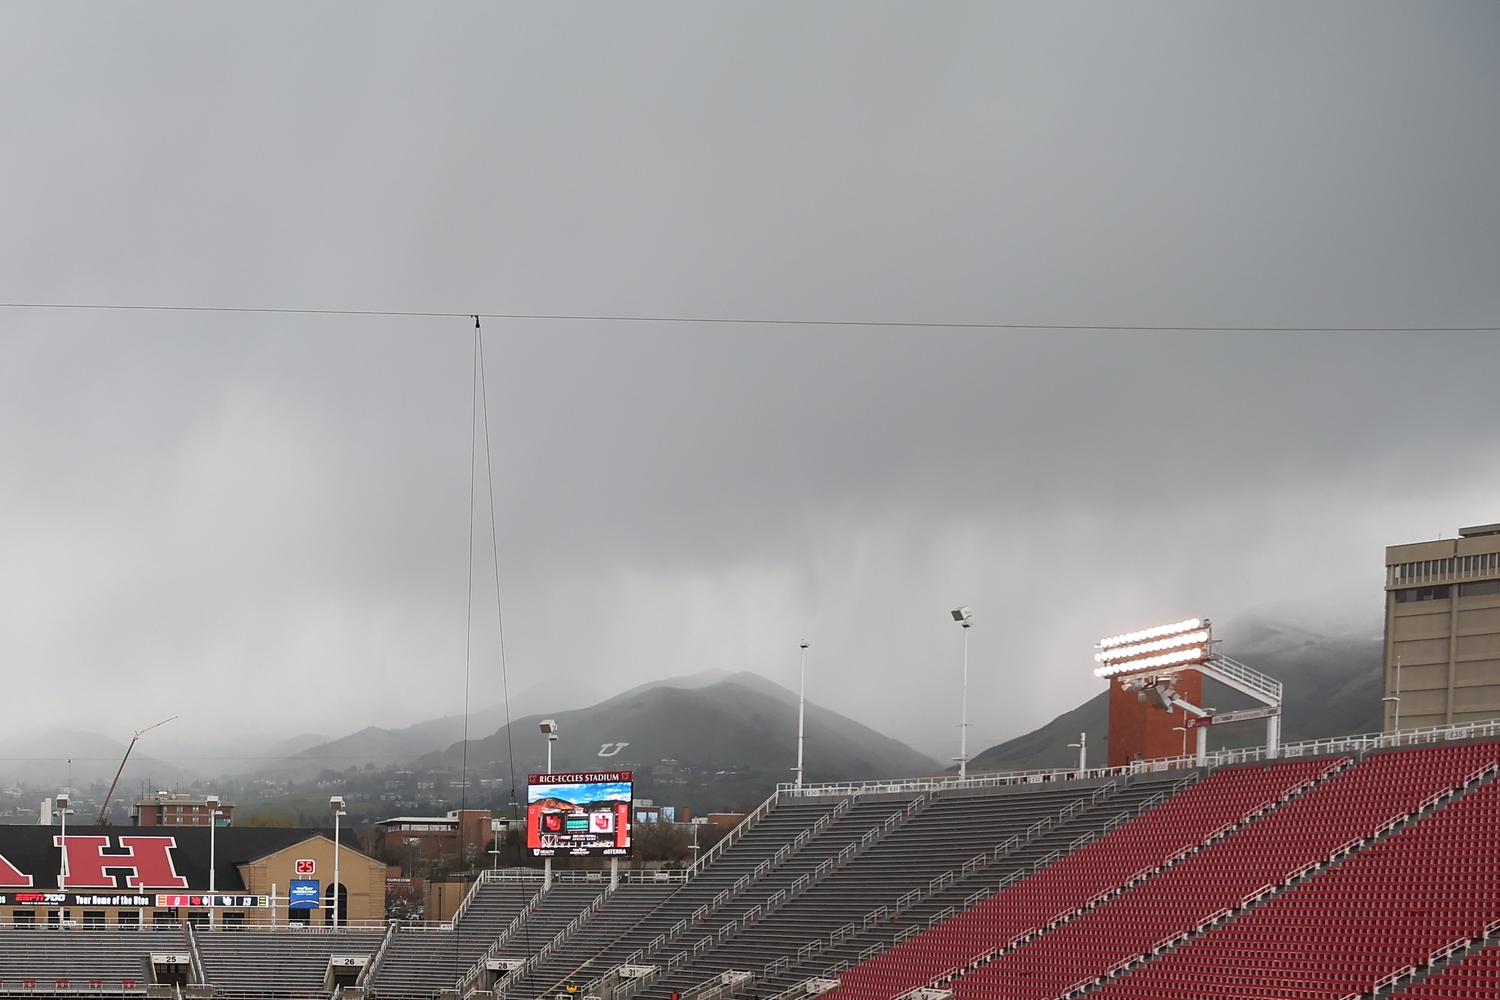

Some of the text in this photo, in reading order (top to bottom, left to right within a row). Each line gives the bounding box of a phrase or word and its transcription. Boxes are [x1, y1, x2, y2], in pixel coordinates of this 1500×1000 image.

[597, 742, 629, 757] U
[585, 774, 619, 782] STADIUM
[298, 863, 312, 872] 25
[76, 895, 149, 905] Your Home of the Utes
[243, 897, 251, 906] 13
[498, 962, 507, 970] 28
[628, 969, 636, 977] 31
